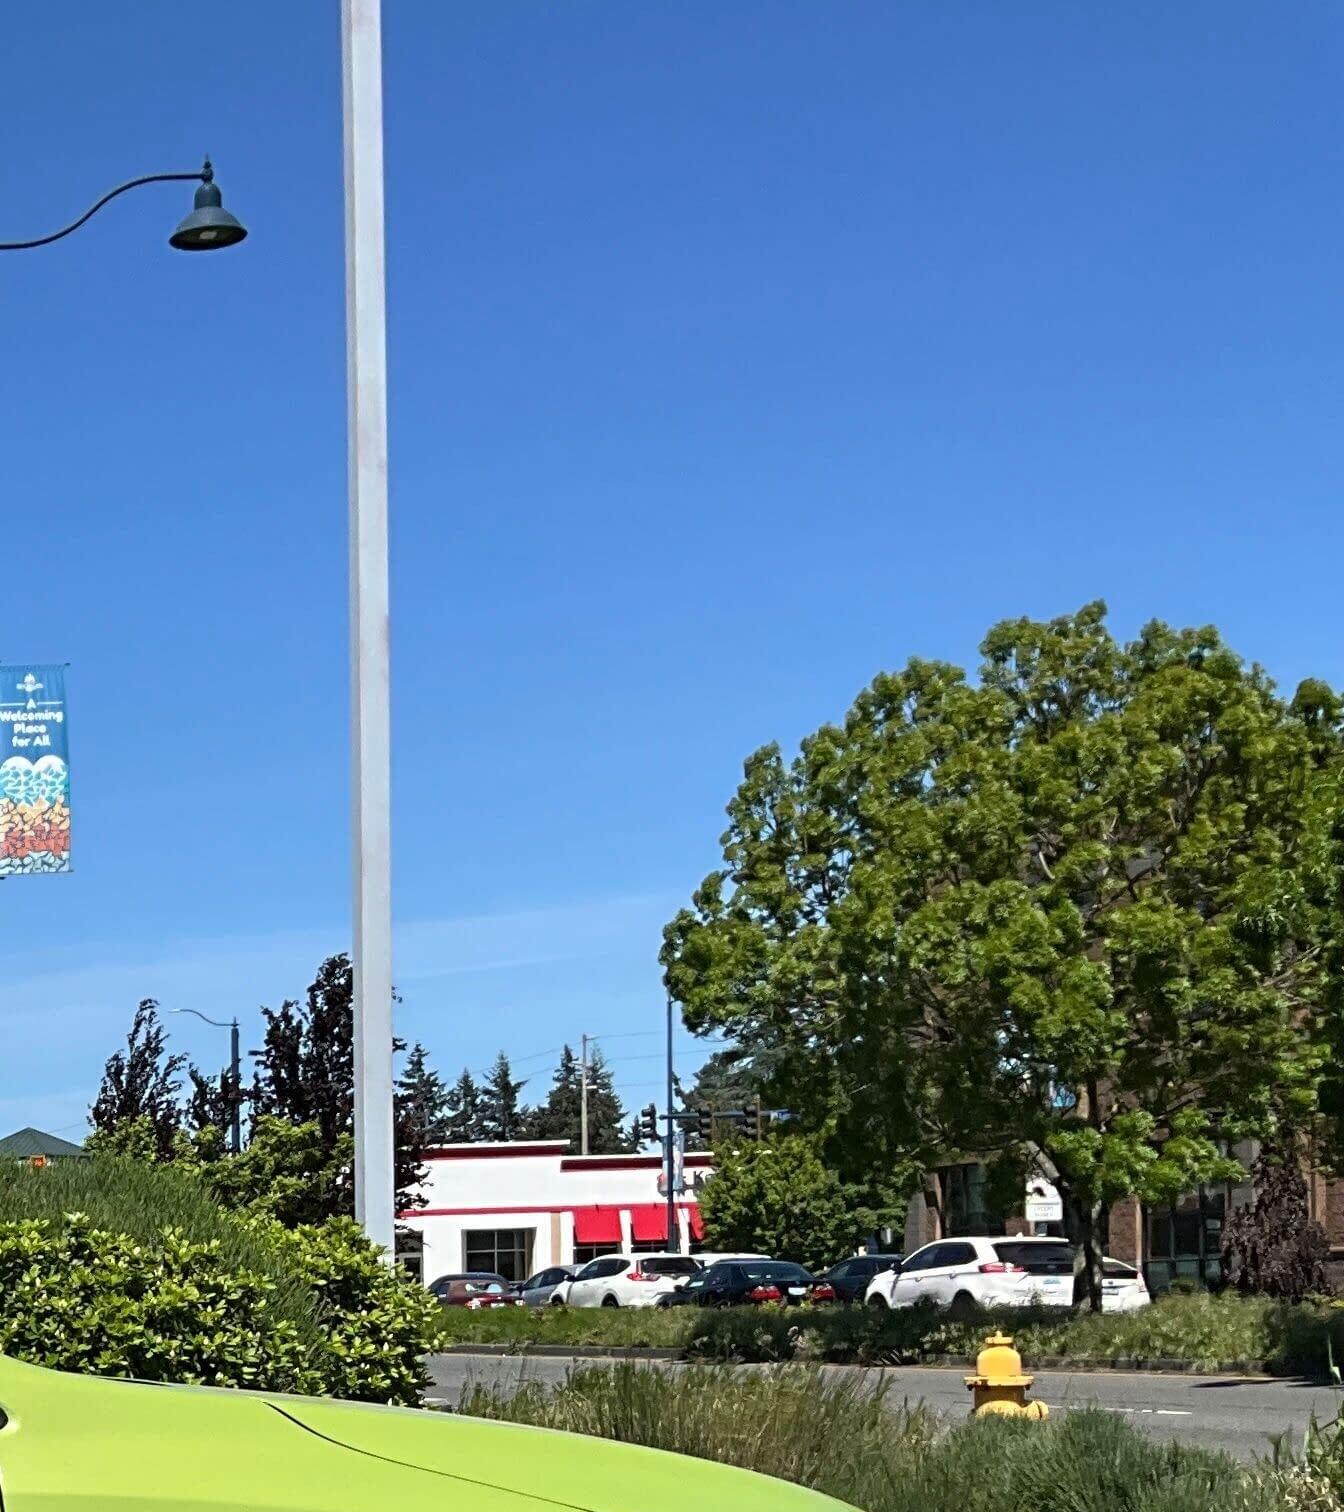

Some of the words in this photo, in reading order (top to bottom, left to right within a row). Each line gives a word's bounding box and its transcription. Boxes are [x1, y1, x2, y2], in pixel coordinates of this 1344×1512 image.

[27, 698, 36, 709] A
[0, 710, 63, 723] Welcoming
[14, 722, 46, 734] Place
[12, 735, 31, 747] for
[33, 735, 51, 746] All
